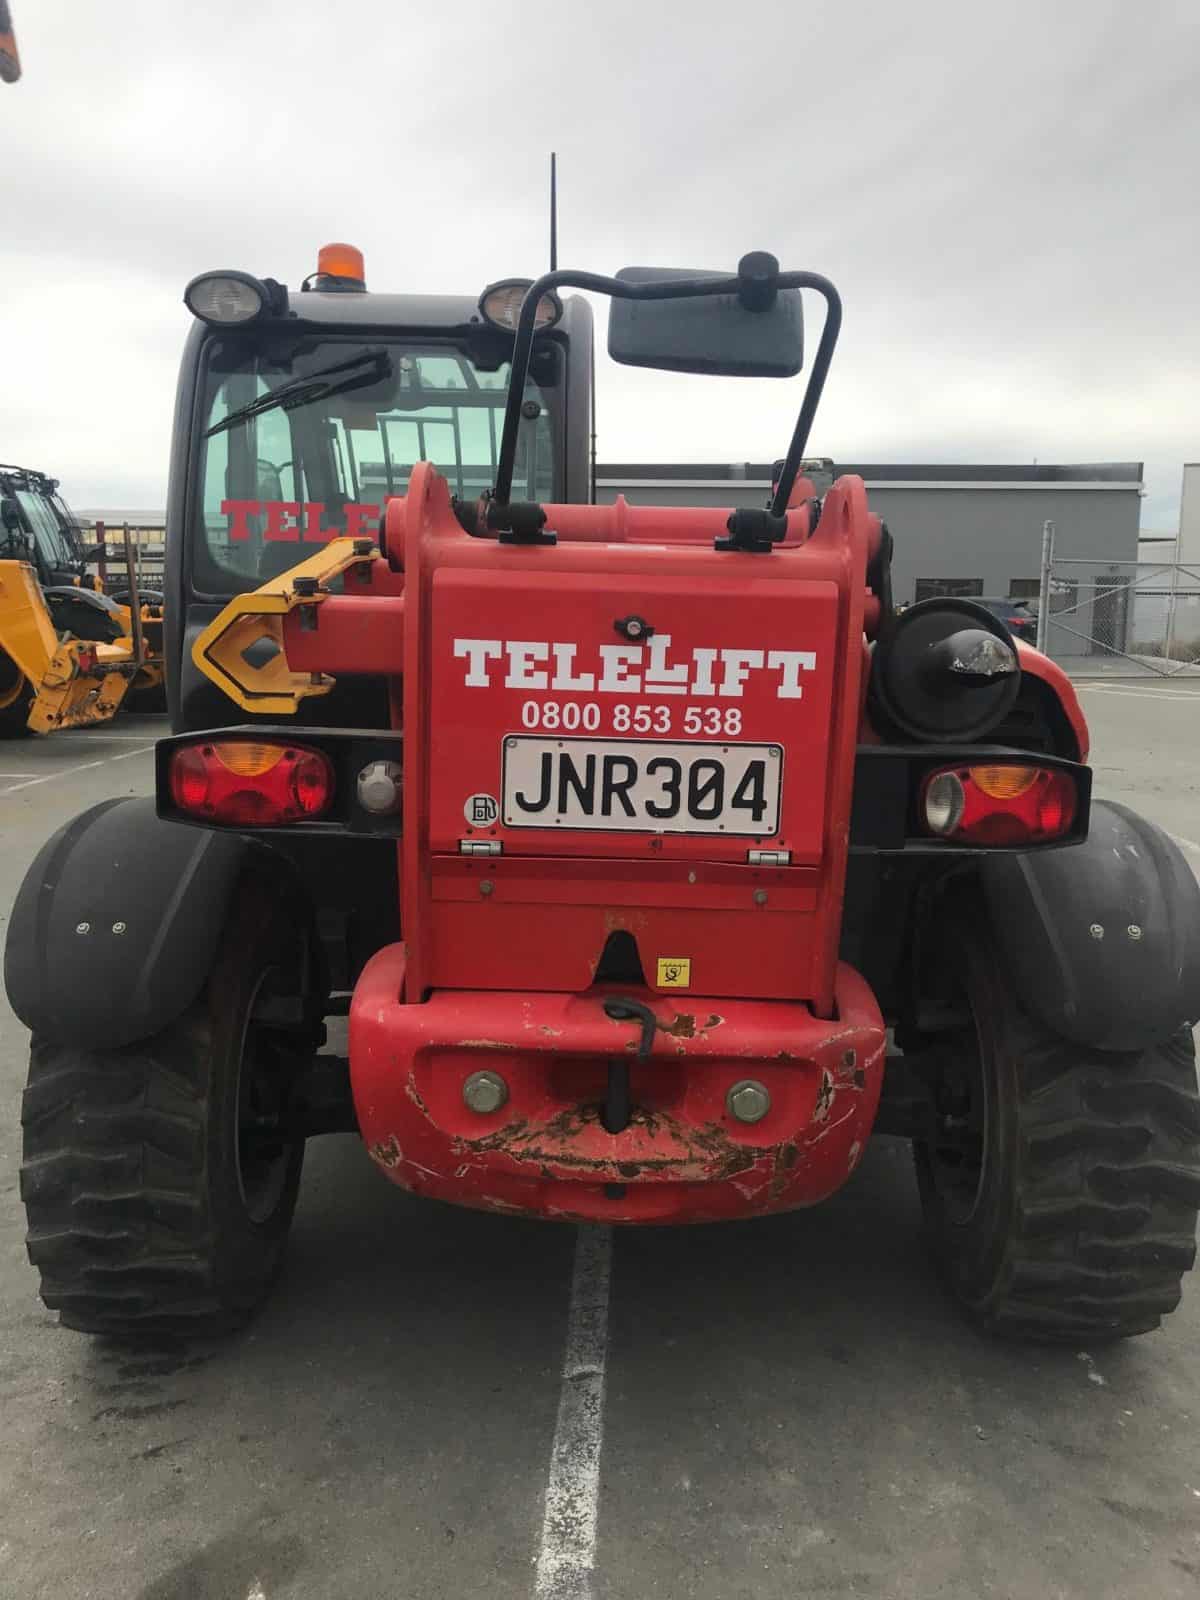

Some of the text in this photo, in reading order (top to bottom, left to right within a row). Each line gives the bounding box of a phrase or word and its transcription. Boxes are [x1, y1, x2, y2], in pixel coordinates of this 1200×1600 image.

[221, 497, 402, 543] TELE
[453, 634, 817, 699] TELELIFT
[521, 700, 743, 737] 0800 853 538
[515, 752, 768, 822] JNR304
